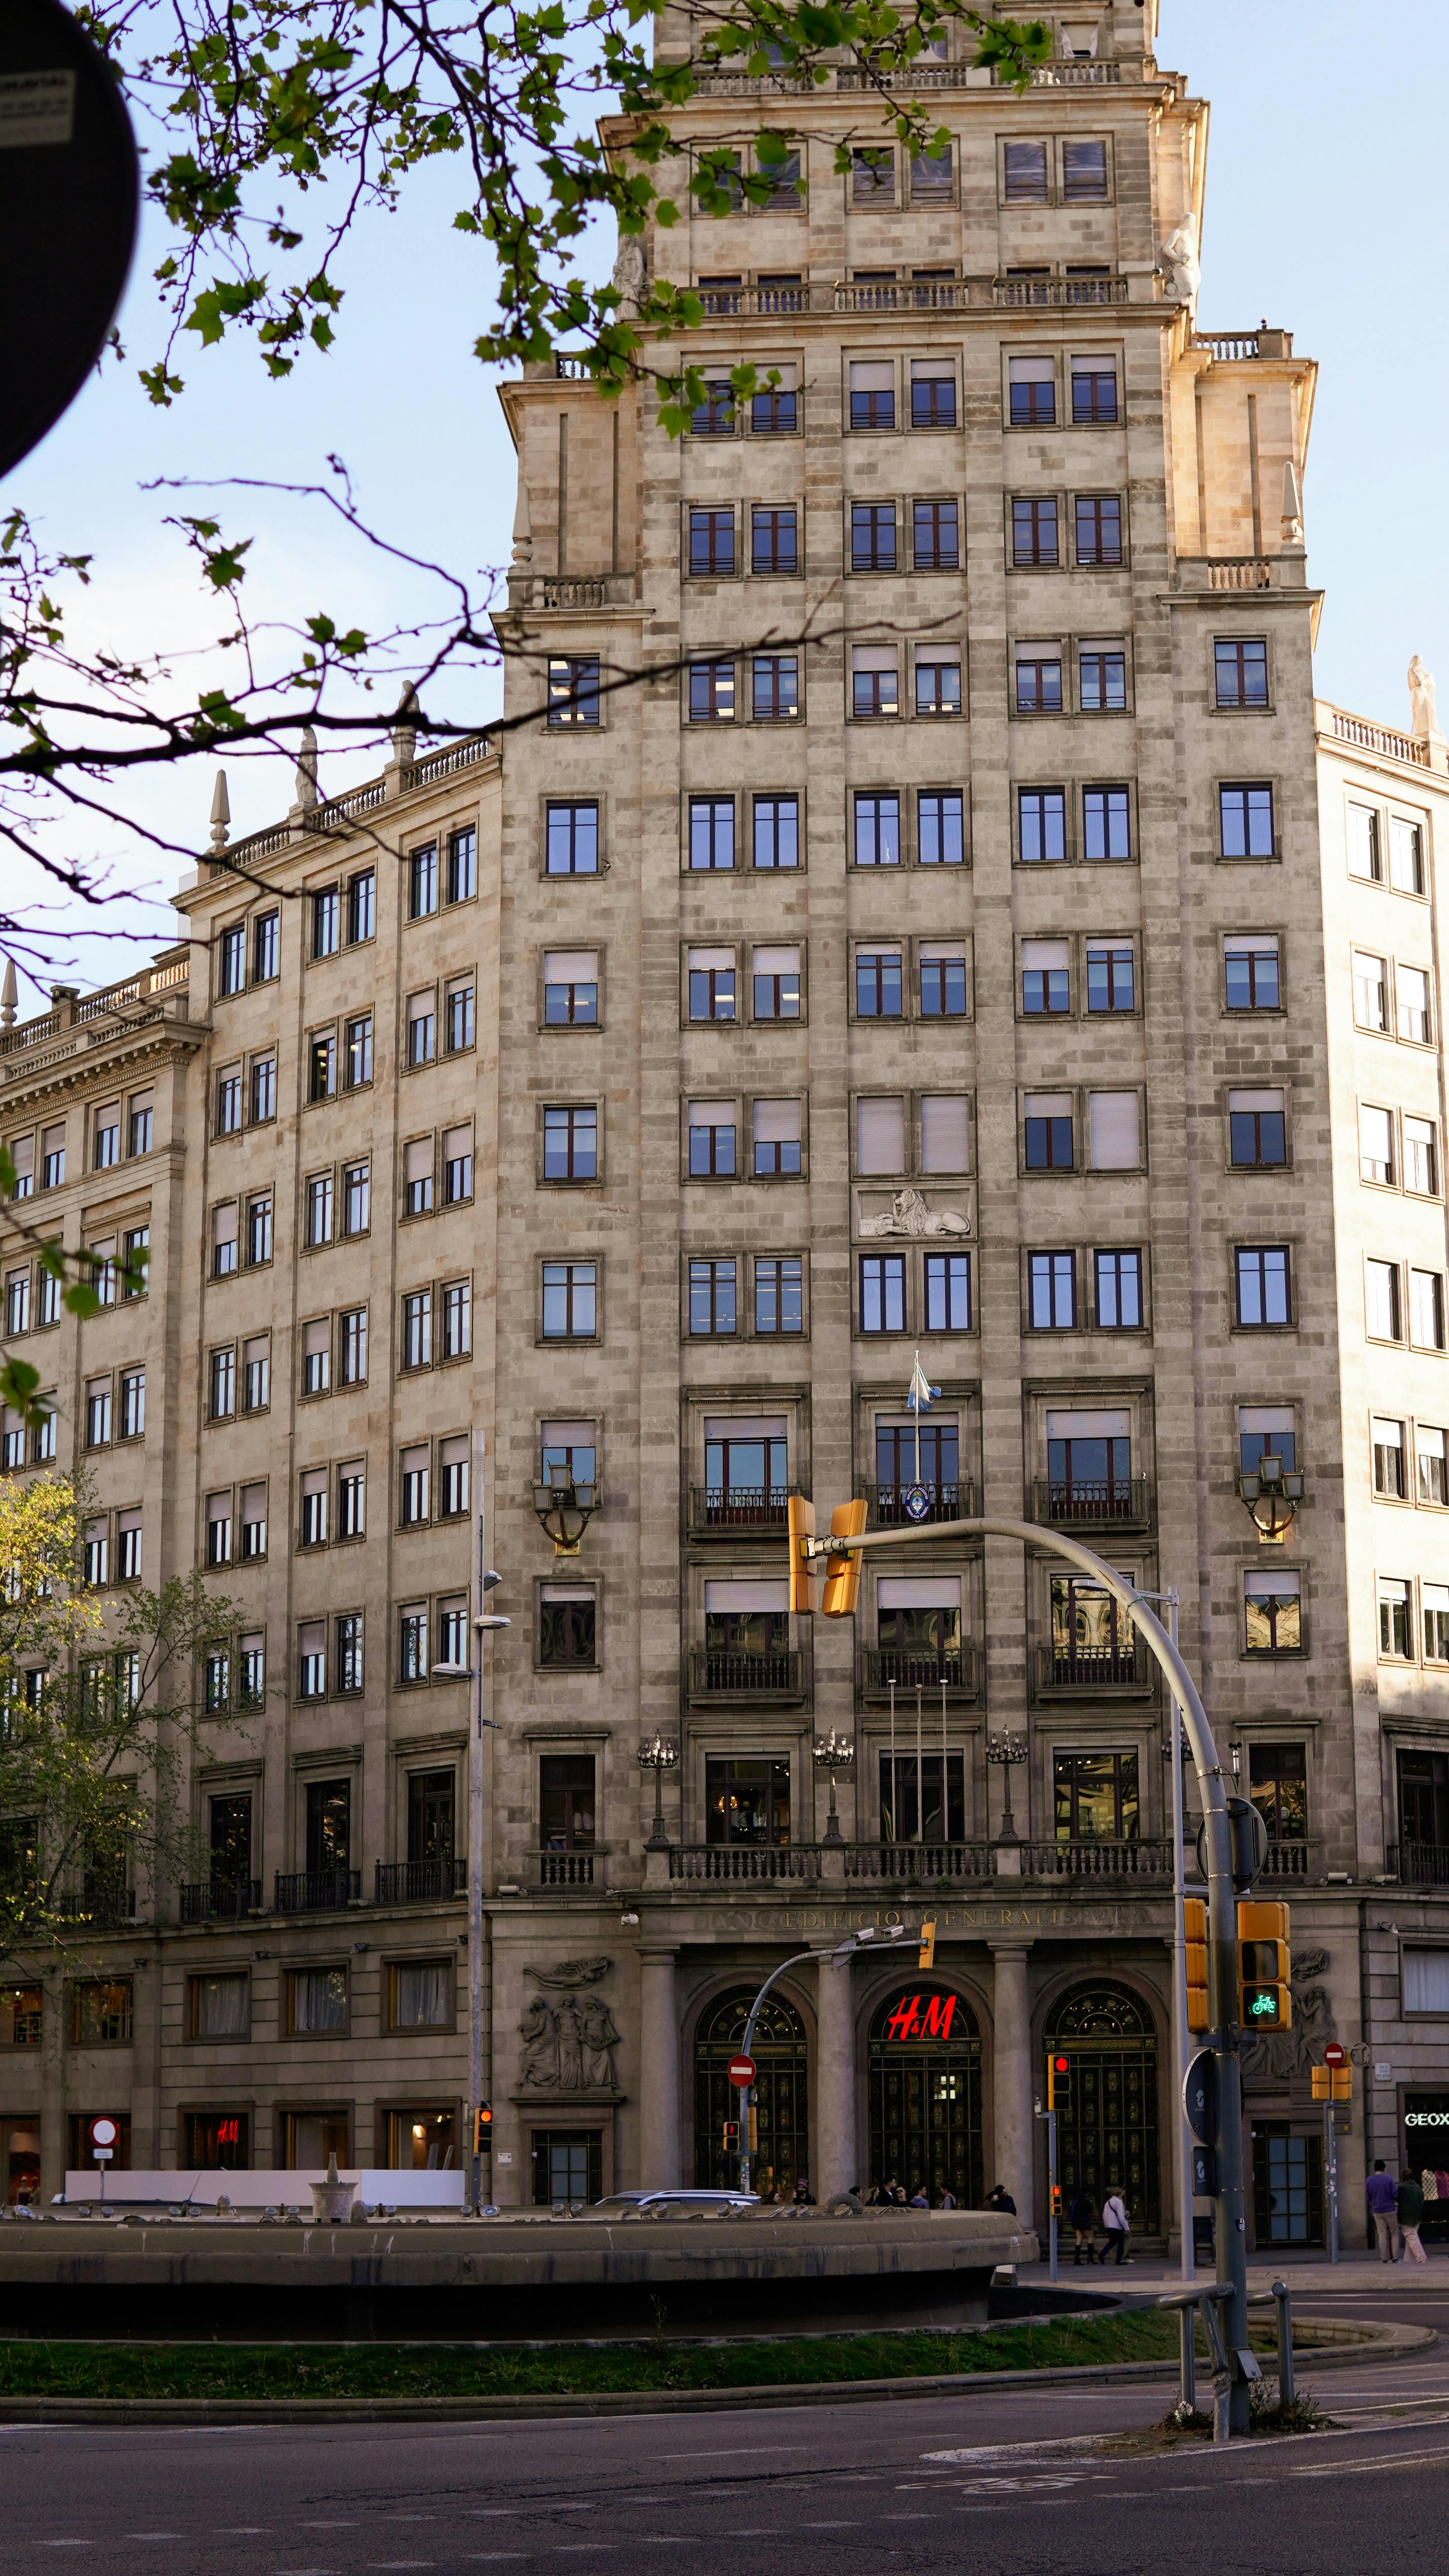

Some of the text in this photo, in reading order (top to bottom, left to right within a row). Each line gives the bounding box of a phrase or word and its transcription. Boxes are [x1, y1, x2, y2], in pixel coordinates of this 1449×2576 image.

[786, 1911, 901, 1928] EDIFICIO
[923, 1908, 1058, 1926] GENERALI
[888, 1995, 957, 2041] H&M
[1404, 2113, 1449, 2126] GEOX
